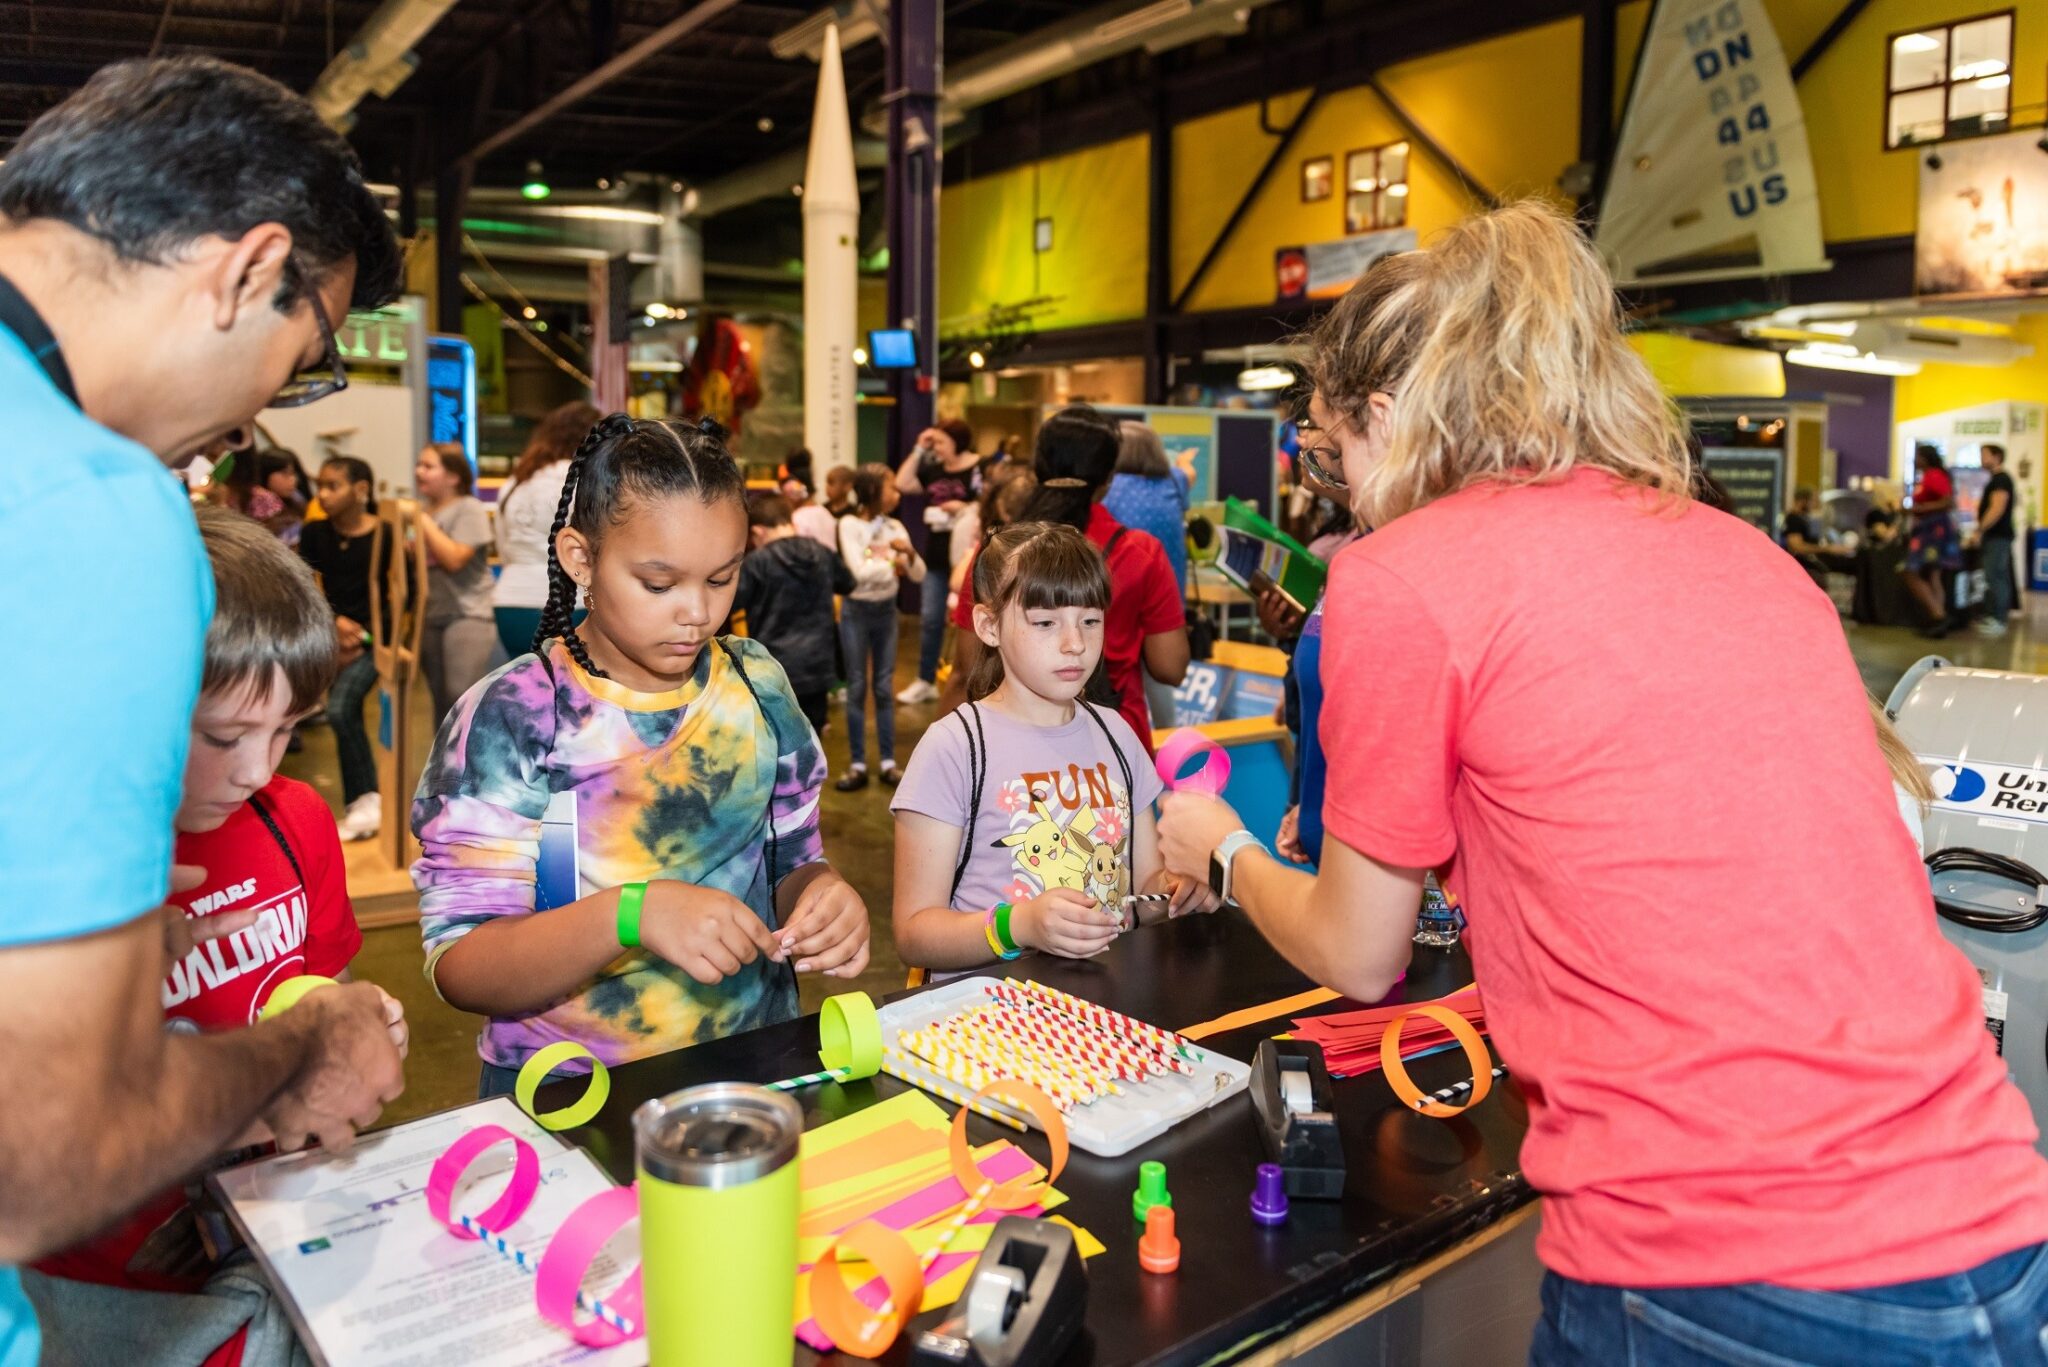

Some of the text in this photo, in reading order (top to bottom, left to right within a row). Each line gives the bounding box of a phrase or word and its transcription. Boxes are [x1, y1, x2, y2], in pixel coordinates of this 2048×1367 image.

[1694, 33, 1751, 81] DN
[1728, 175, 1788, 217] US
[1020, 762, 1115, 813] FUN
[1997, 772, 2048, 793] Un
[189, 877, 257, 917] WARS
